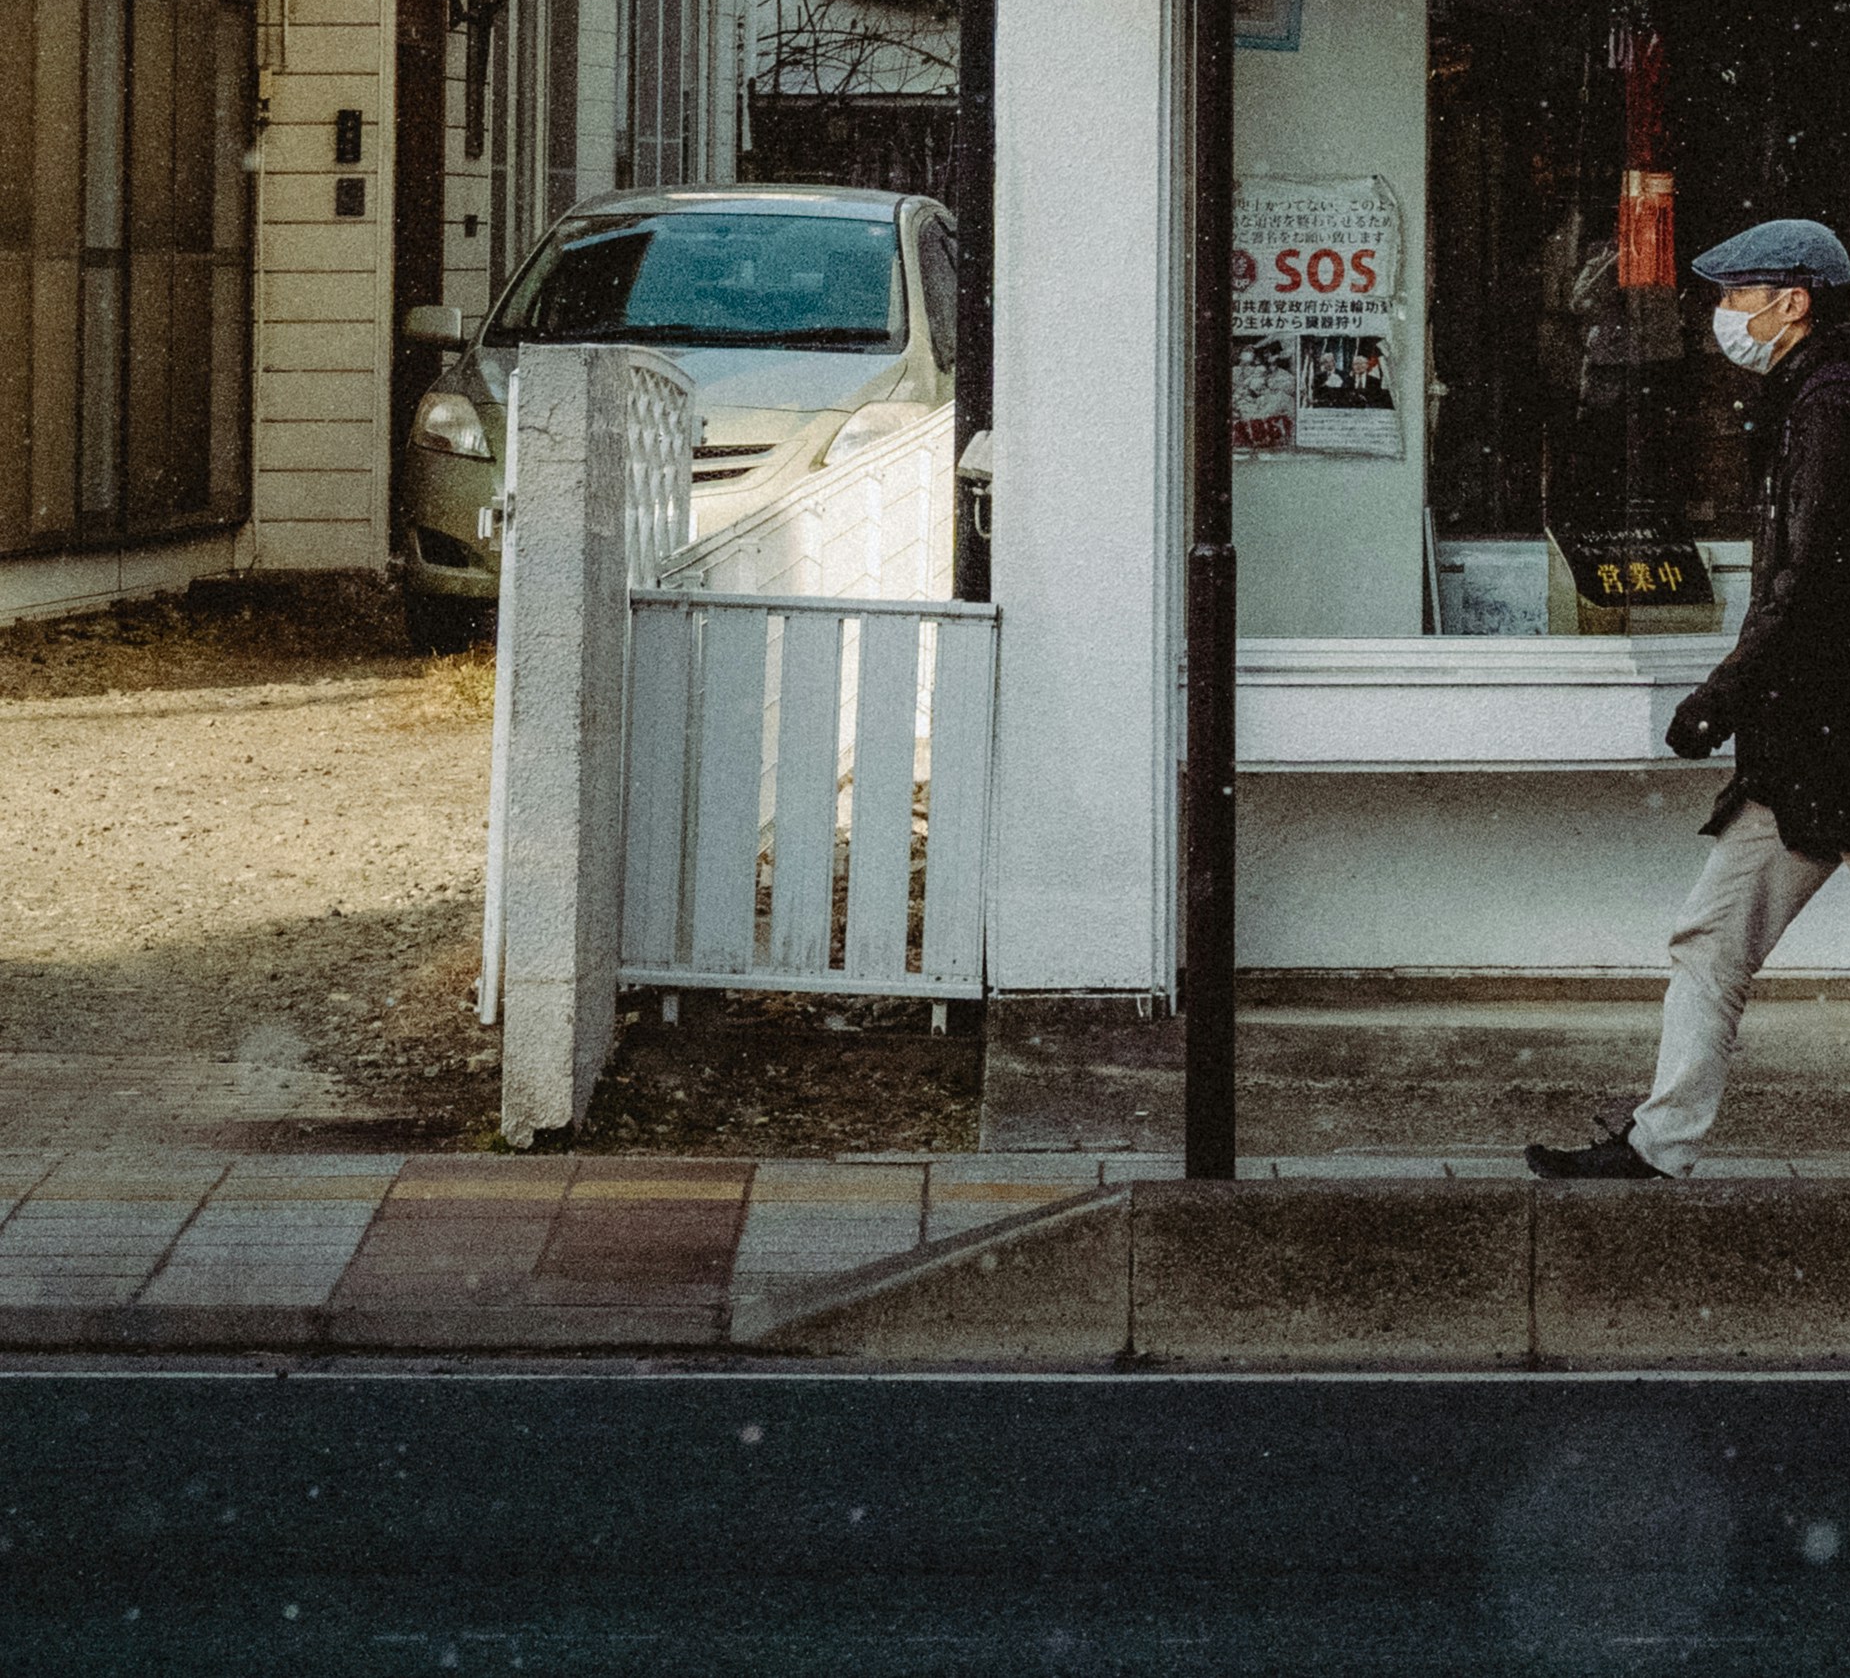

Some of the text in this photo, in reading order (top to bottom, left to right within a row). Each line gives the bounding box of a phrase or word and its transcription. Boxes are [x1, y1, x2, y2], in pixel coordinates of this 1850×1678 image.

[1275, 248, 1377, 293] SOS
[1597, 561, 1683, 594] 営業中
